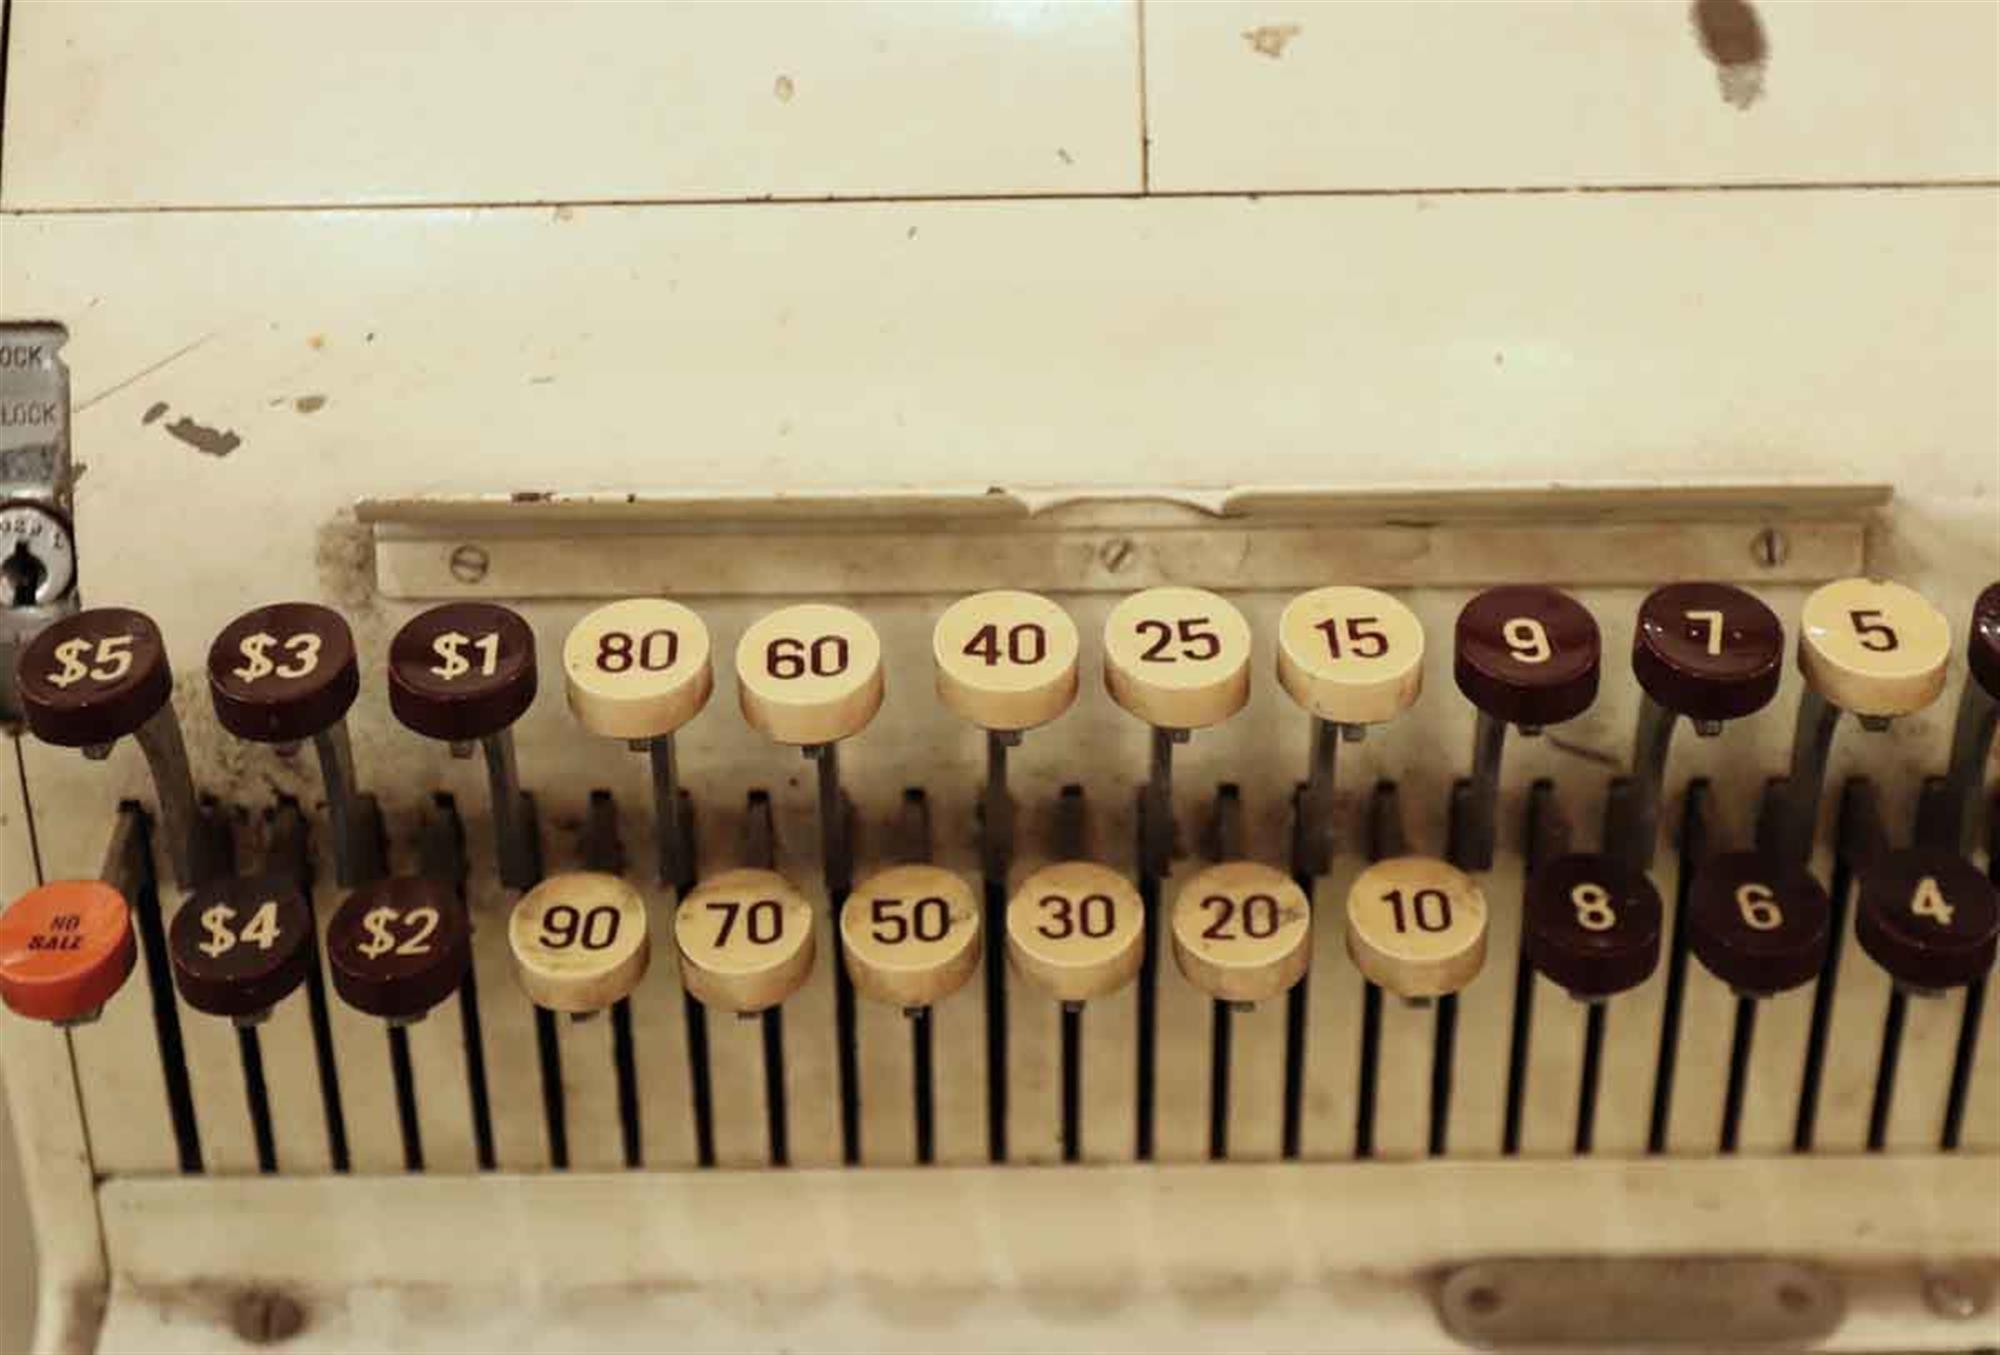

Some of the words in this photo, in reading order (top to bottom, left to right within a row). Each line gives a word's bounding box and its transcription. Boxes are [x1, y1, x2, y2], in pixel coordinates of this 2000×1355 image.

[595, 629, 678, 673] 80
[962, 623, 1045, 665] 40
[1136, 618, 1220, 662] 25
[1315, 618, 1389, 658] 15
[1504, 618, 1550, 663] 9
[1687, 611, 1723, 654] 7
[1850, 611, 1898, 652] 5
[47, 634, 133, 687] $5
[233, 632, 321, 682] $3
[431, 631, 498, 680] $1
[766, 635, 848, 679] 60
[51, 915, 81, 932] NO
[706, 900, 783, 947] 70
[871, 897, 950, 944] 50
[1038, 894, 1115, 939] 30
[1200, 894, 1280, 940] 20
[1382, 889, 1452, 933] 10
[1572, 885, 1615, 930] 8
[1737, 884, 1782, 929] 6
[1912, 878, 1953, 924] 4
[27, 934, 83, 951] SALE
[199, 902, 280, 957] $4
[359, 906, 439, 959] $2
[540, 905, 620, 950] 90
